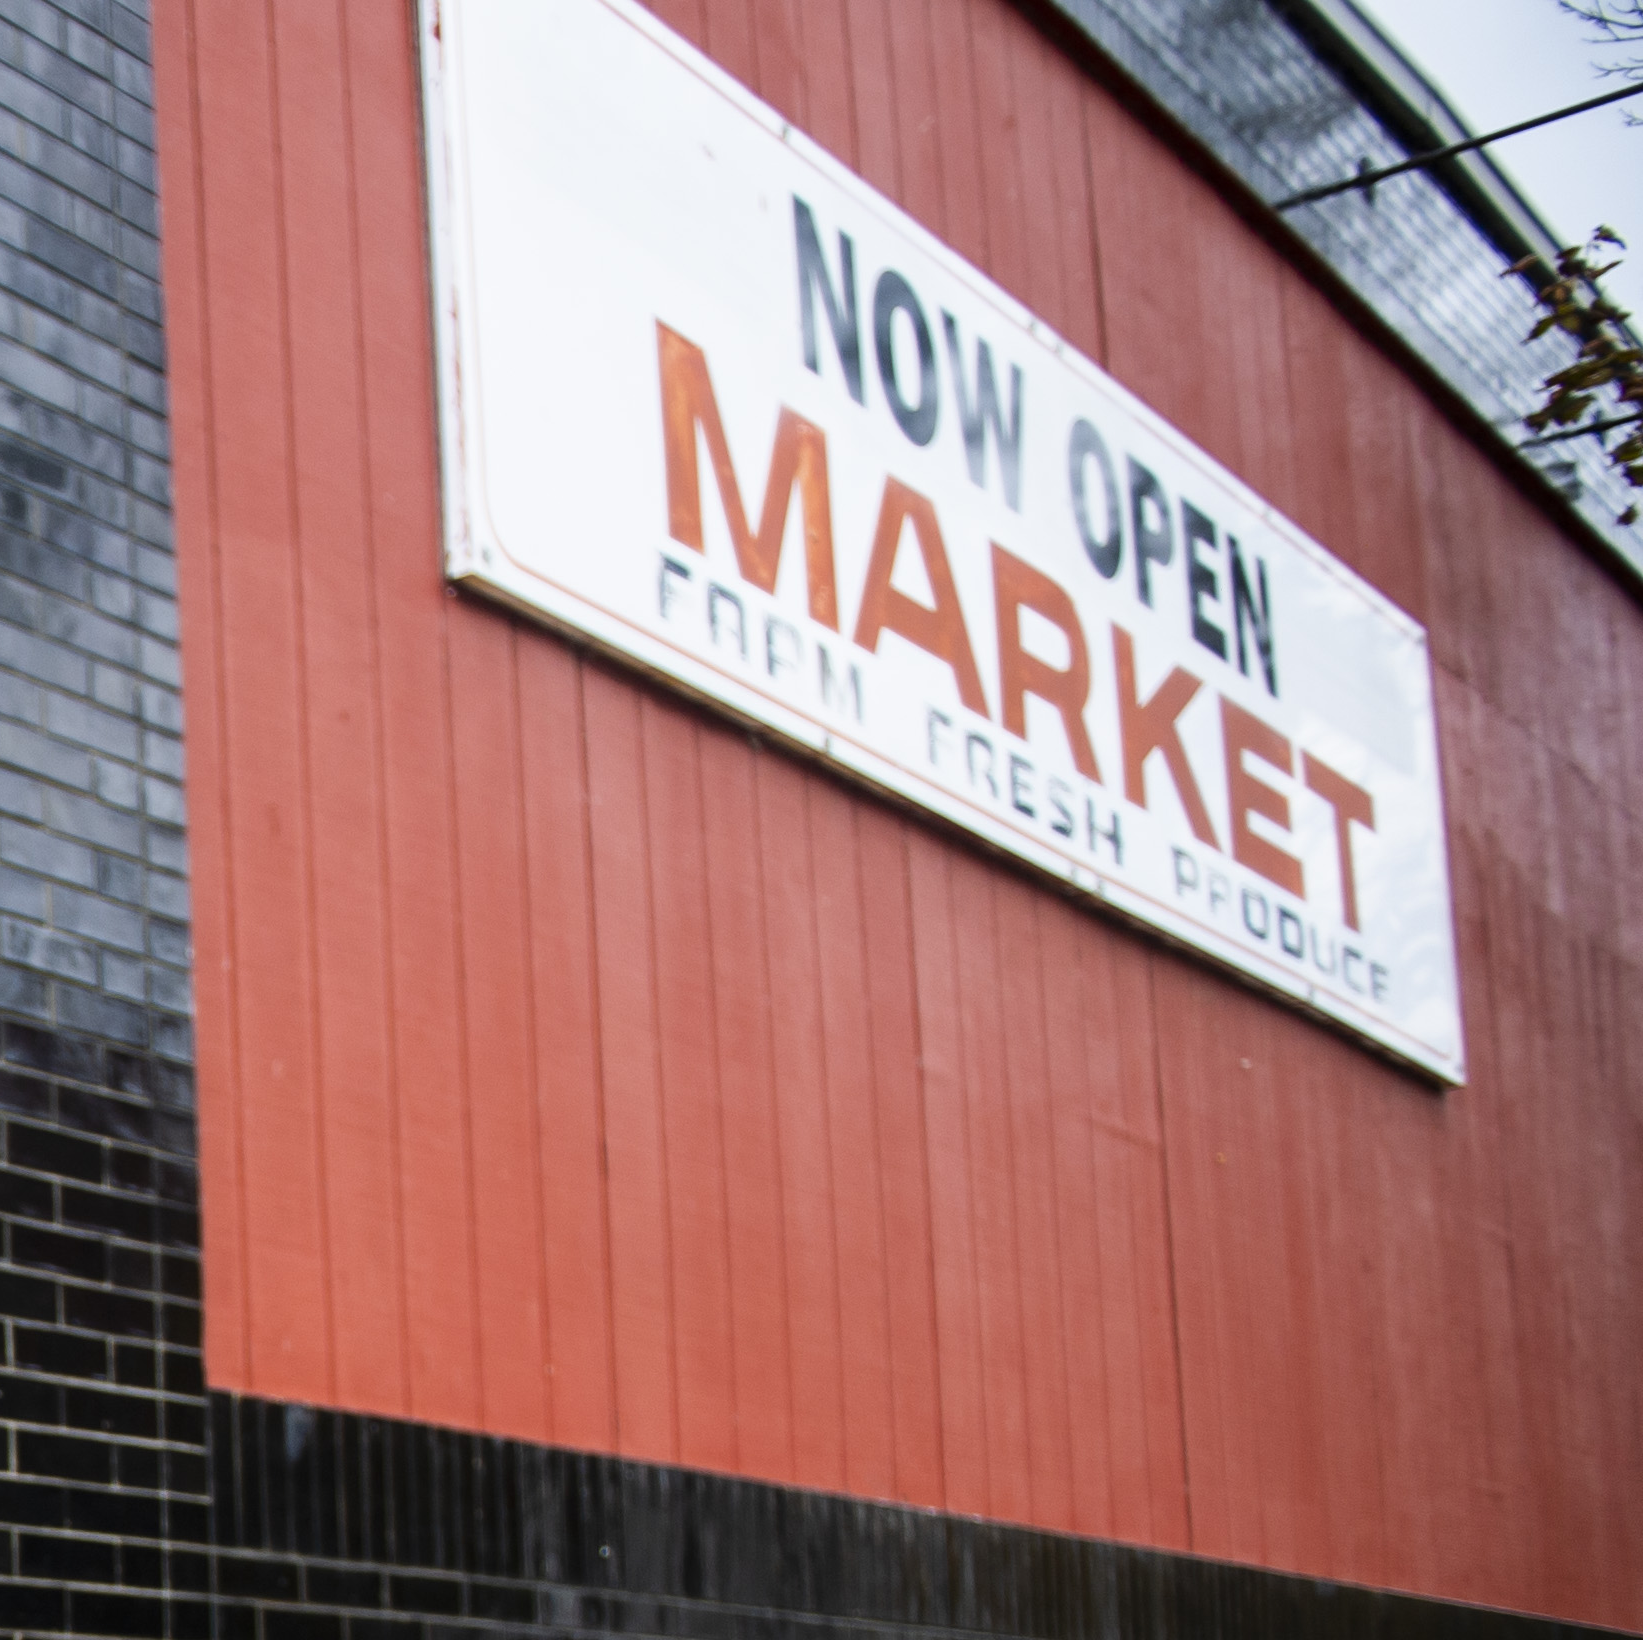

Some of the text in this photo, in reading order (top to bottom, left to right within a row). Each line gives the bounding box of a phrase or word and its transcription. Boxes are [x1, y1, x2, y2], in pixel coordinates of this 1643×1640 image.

[654, 317, 1375, 935] MARKET
[792, 192, 1279, 699] NOW OPEN
[927, 703, 1124, 867] FRESH
[1171, 842, 1390, 1004] PRODUCE
